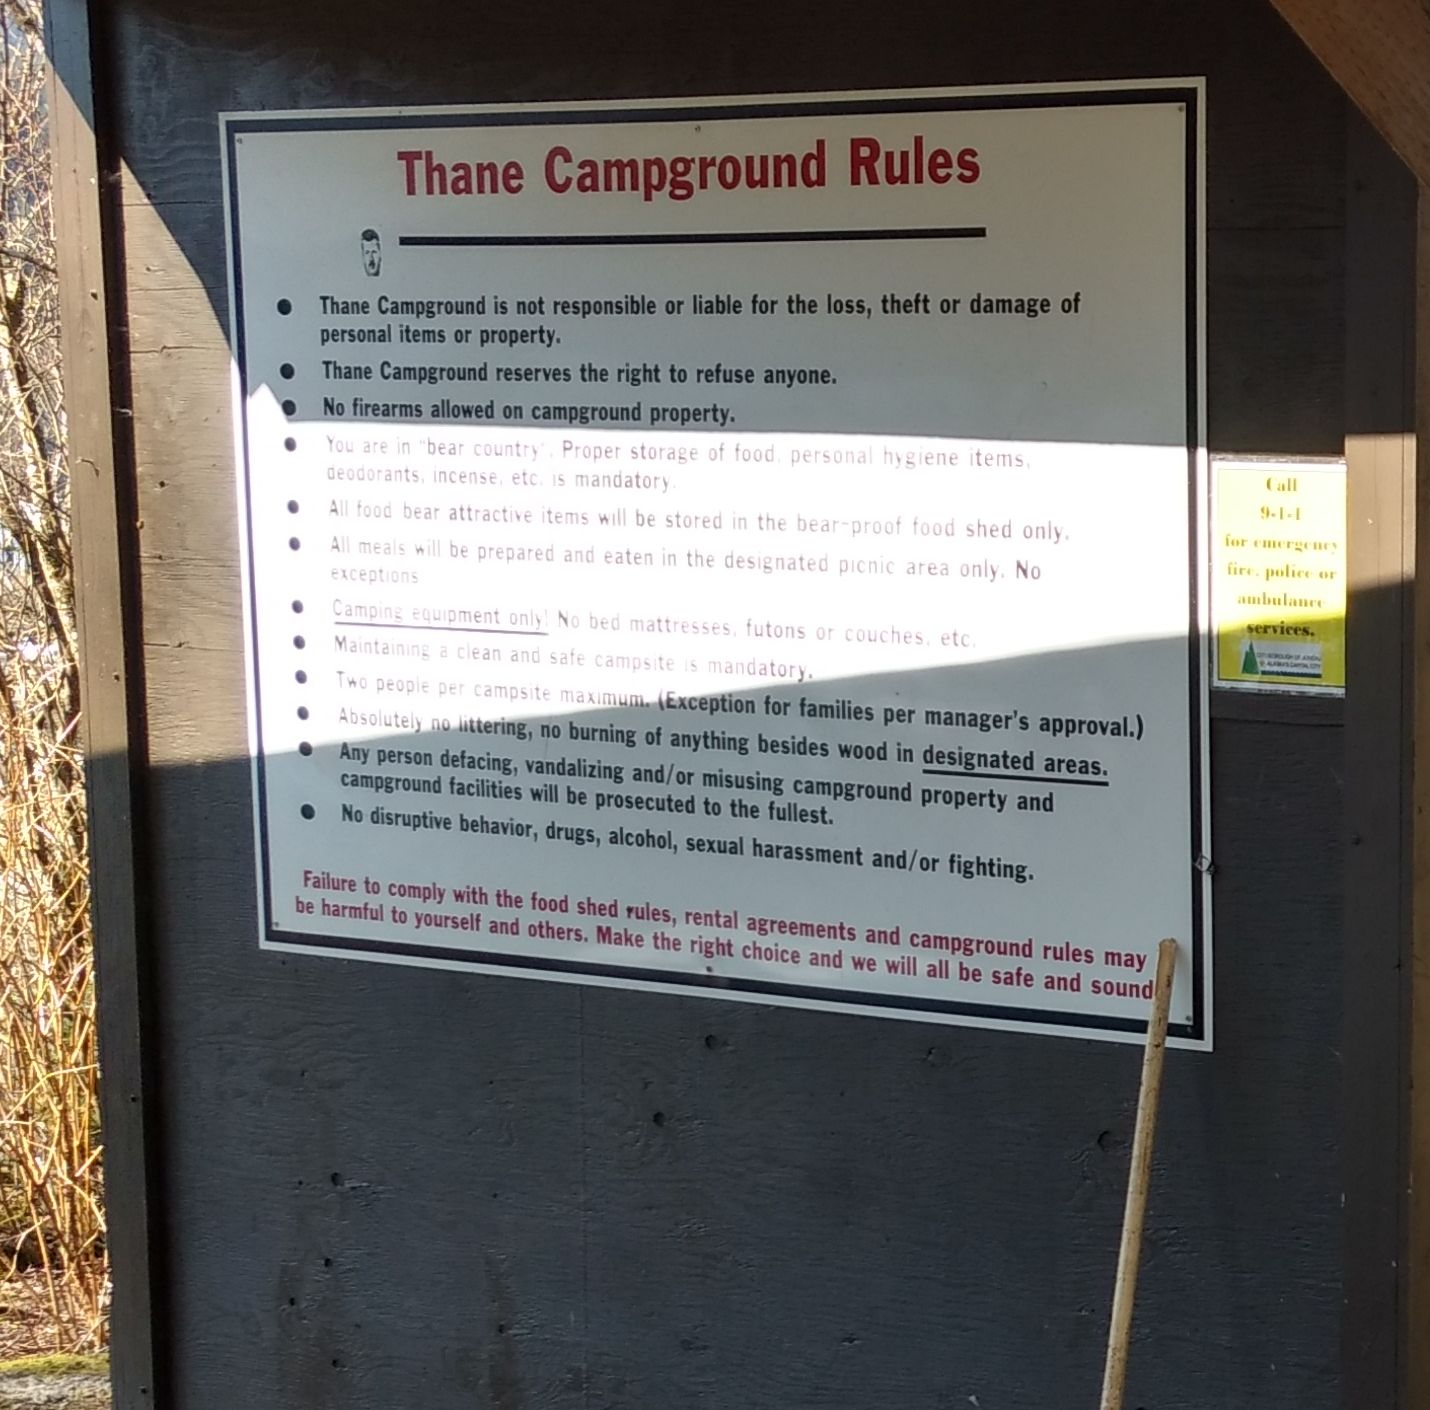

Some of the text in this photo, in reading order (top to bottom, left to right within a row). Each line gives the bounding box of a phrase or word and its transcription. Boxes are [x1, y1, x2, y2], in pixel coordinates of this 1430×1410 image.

[397, 135, 980, 202] Thane Campground Rules
[319, 292, 1081, 319] Thane Campground is not responsible or liable for the loss, theft or damage of
[320, 323, 560, 348] personal items or property.
[322, 360, 837, 388] Thane Campground reserves the right to refuse anyone.
[323, 397, 735, 427] No firearms allowed on campground property.
[1266, 477, 1297, 492] Call
[1260, 505, 1301, 521] 9-1-1
[1225, 534, 1337, 554] for emergency
[1265, 564, 1313, 581] police
[1319, 569, 1337, 580] or
[1238, 592, 1325, 608] ambulance
[333, 598, 403, 622] Camping
[412, 608, 500, 625] equipment
[558, 609, 580, 629] No
[589, 611, 620, 631] bed
[746, 618, 806, 640] futons
[816, 626, 835, 640] or
[1246, 620, 1315, 637] services.
[334, 634, 813, 682] Maintaining a clean and safe campsite is mandatory.
[336, 670, 1143, 741] Two people per campsite maximum. (Exception for families per manager's approval.)
[339, 706, 1108, 776] Absolutely no littering, no burning of anything besides wood in designated areas.
[339, 743, 1054, 813] Any person defacing, vandalizing and/or misusing campground property and
[341, 773, 833, 825] campground facilities will be prosecuted to the fullest.
[342, 804, 1034, 884] No disruptive behavior, drugs, alcohol, sexual harassment and/or fighting.
[304, 870, 1147, 973] Failure to comply with the food shed rules, rental agreements and campground rules may
[295, 896, 314, 914] be
[321, 898, 384, 922] harmful
[390, 906, 408, 924] to
[415, 912, 481, 932] yourself
[489, 917, 520, 936] and
[528, 920, 588, 942] others.
[596, 925, 644, 948] Make
[652, 931, 681, 952] the
[690, 935, 734, 959] right
[742, 940, 800, 964] choice
[809, 949, 842, 968] and
[851, 956, 877, 972] we
[885, 956, 917, 976] will
[927, 959, 949, 979] all
[959, 961, 982, 983] be
[992, 966, 1034, 988] safe
[1044, 972, 1081, 992] and
